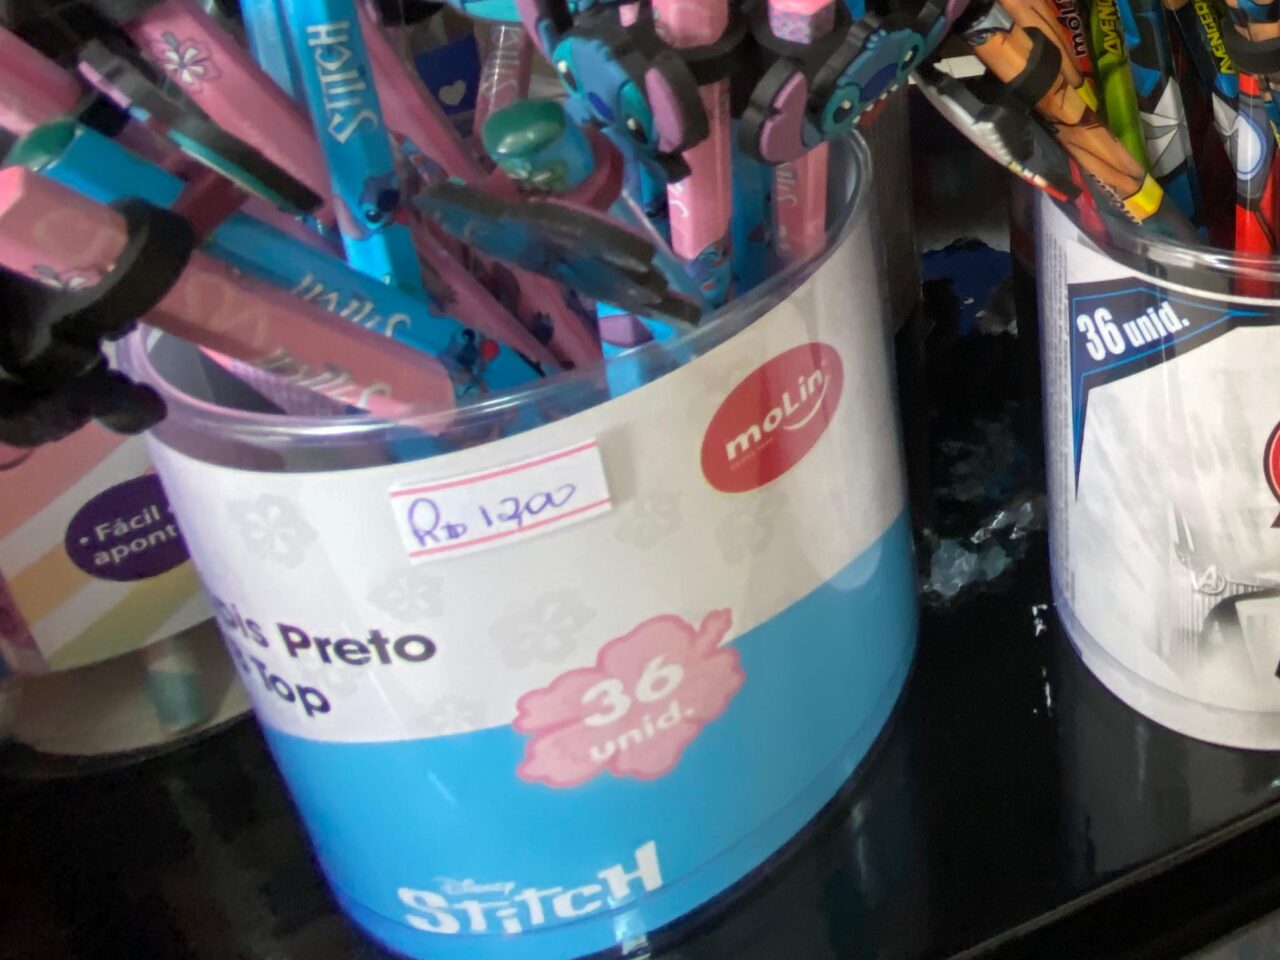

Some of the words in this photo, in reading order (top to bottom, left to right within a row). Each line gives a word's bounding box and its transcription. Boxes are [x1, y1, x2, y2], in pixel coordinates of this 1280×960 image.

[306, 20, 381, 144] STITCH
[1076, 307, 1126, 362] 36
[1122, 300, 1191, 348] unid.
[95, 505, 161, 541] Fácil
[277, 622, 437, 666] Preto
[251, 656, 332, 718] Top
[581, 654, 685, 727] 36
[590, 699, 695, 763] unid.
